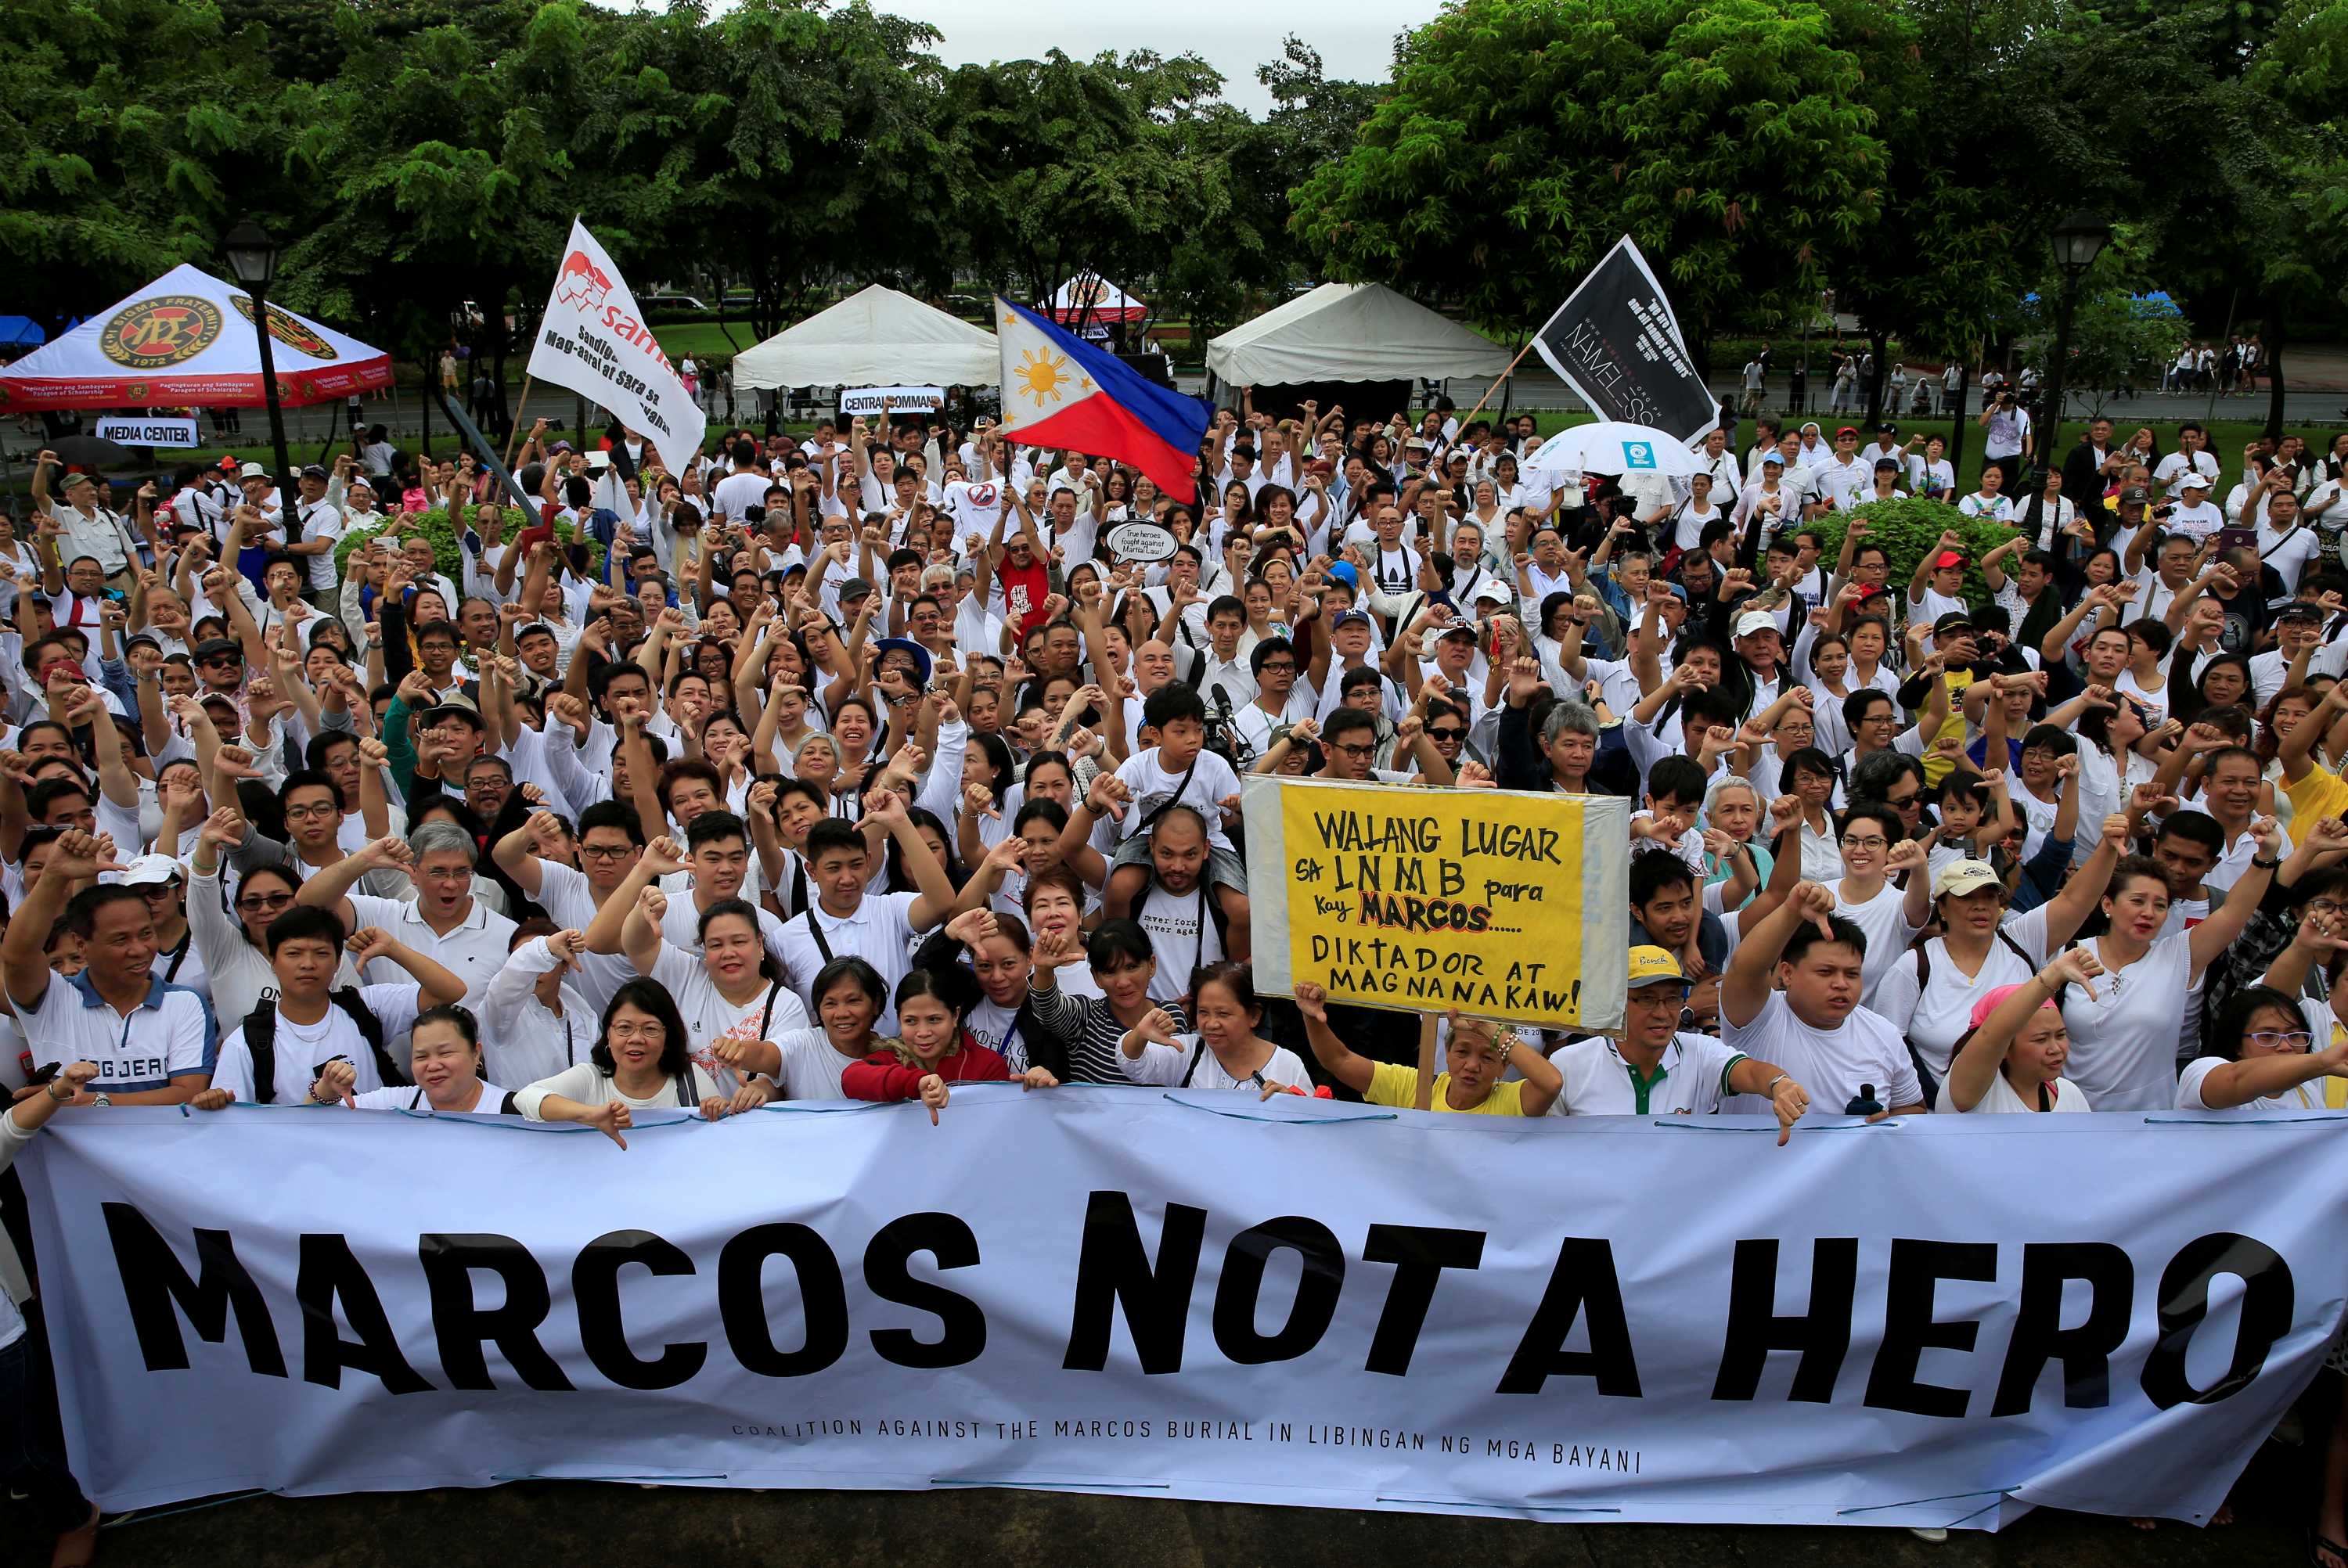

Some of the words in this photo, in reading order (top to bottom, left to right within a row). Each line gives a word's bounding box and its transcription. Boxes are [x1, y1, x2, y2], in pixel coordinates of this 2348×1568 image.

[113, 301, 158, 326] SIGMA
[165, 298, 218, 337] FRATERNITY
[1627, 297, 1644, 315] and
[1637, 312, 1652, 325] all
[1645, 322, 1668, 350] names
[1662, 346, 1677, 362] are
[1656, 313, 1670, 329] are
[133, 357, 167, 366] 1972
[545, 329, 602, 372] Mag-aaral
[602, 364, 617, 380] at
[646, 388, 660, 407] sa
[1565, 322, 1654, 426] NAMELESS
[889, 395, 938, 409] OMMAN
[103, 426, 142, 442] MEDIA
[144, 426, 189, 443] CENTER
[1122, 537, 1140, 547] fought
[1140, 539, 1165, 548] against
[1140, 530, 1161, 539] heroes
[1313, 810, 1442, 854] WALANG
[1461, 818, 1562, 866] LUGAR
[1295, 858, 1324, 883] SA
[1483, 878, 1543, 908] para
[1143, 915, 1170, 924] never
[1174, 918, 1197, 927] forg
[1145, 924, 1172, 933] never
[1176, 926, 1200, 937] agai
[1312, 934, 1484, 977] DIKTADOR
[1505, 961, 1547, 984] AT
[1330, 967, 1582, 1015] MAGNANAKAW!
[1531, 1028, 1542, 1037] 20
[100, 1201, 988, 1396] MARCOS
[1062, 1190, 1488, 1378] NOT
[1494, 1236, 1644, 1399] A
[1709, 1231, 2296, 1419] HERO
[732, 1419, 862, 1437] COALITION
[877, 1419, 981, 1439] AGAINST
[995, 1420, 1038, 1440] THE
[1054, 1420, 1151, 1438] MARCOS
[1167, 1421, 1253, 1440] BURIAL
[1269, 1422, 1291, 1443] IN
[1309, 1424, 1424, 1451] LIBINGAN
[1441, 1435, 1470, 1455] NG
[1487, 1438, 1536, 1462] MGA
[1553, 1443, 1640, 1474] BAYANI
